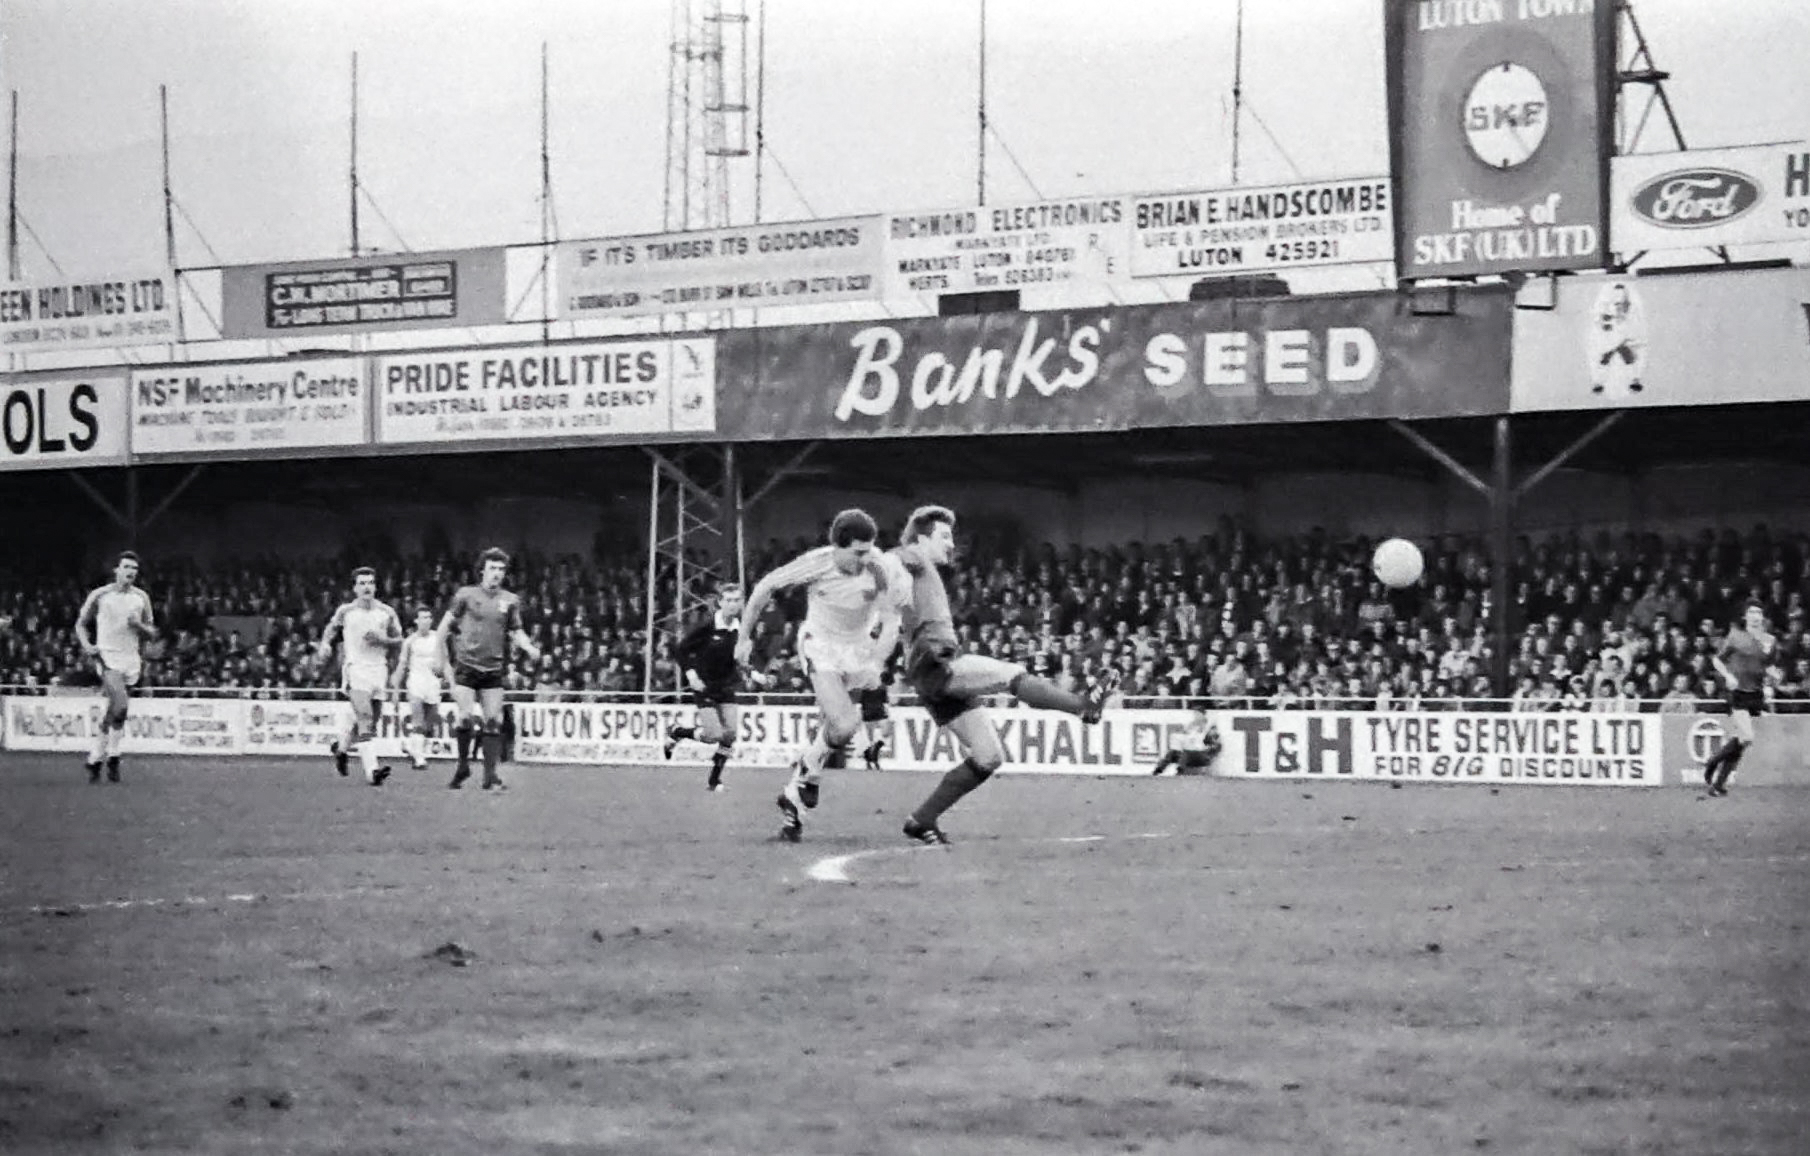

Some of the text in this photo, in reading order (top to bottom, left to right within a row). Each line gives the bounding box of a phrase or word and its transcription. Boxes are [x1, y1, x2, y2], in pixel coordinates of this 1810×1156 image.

[1418, 0, 1503, 30] LUTON
[1468, 101, 1545, 131] SKF
[993, 200, 1122, 232] ELECTRONICS
[1136, 199, 1200, 229] BRIAN
[1226, 184, 1386, 221] HANDSCOMBE
[1451, 191, 1562, 229] Home of
[1652, 177, 1741, 220] Ford
[1178, 247, 1243, 268] LUTON
[387, 351, 658, 394] PRIDE FACILITIES
[1144, 327, 1378, 388] SEED
[185, 373, 287, 406] Machinery
[293, 370, 358, 400] Centre
[387, 396, 487, 417] INDUSTRIAL
[500, 394, 569, 412] LABOUR
[584, 389, 657, 408] AGENCY
[3, 384, 99, 454] OLS
[520, 709, 593, 738] LUTON
[906, 718, 1122, 765] VAXHALL
[1367, 717, 1643, 757] TYRE SERVICE LTD
[1233, 716, 1353, 775] T&H
[1375, 756, 1645, 780] FOR BIG DISCOUNTS
